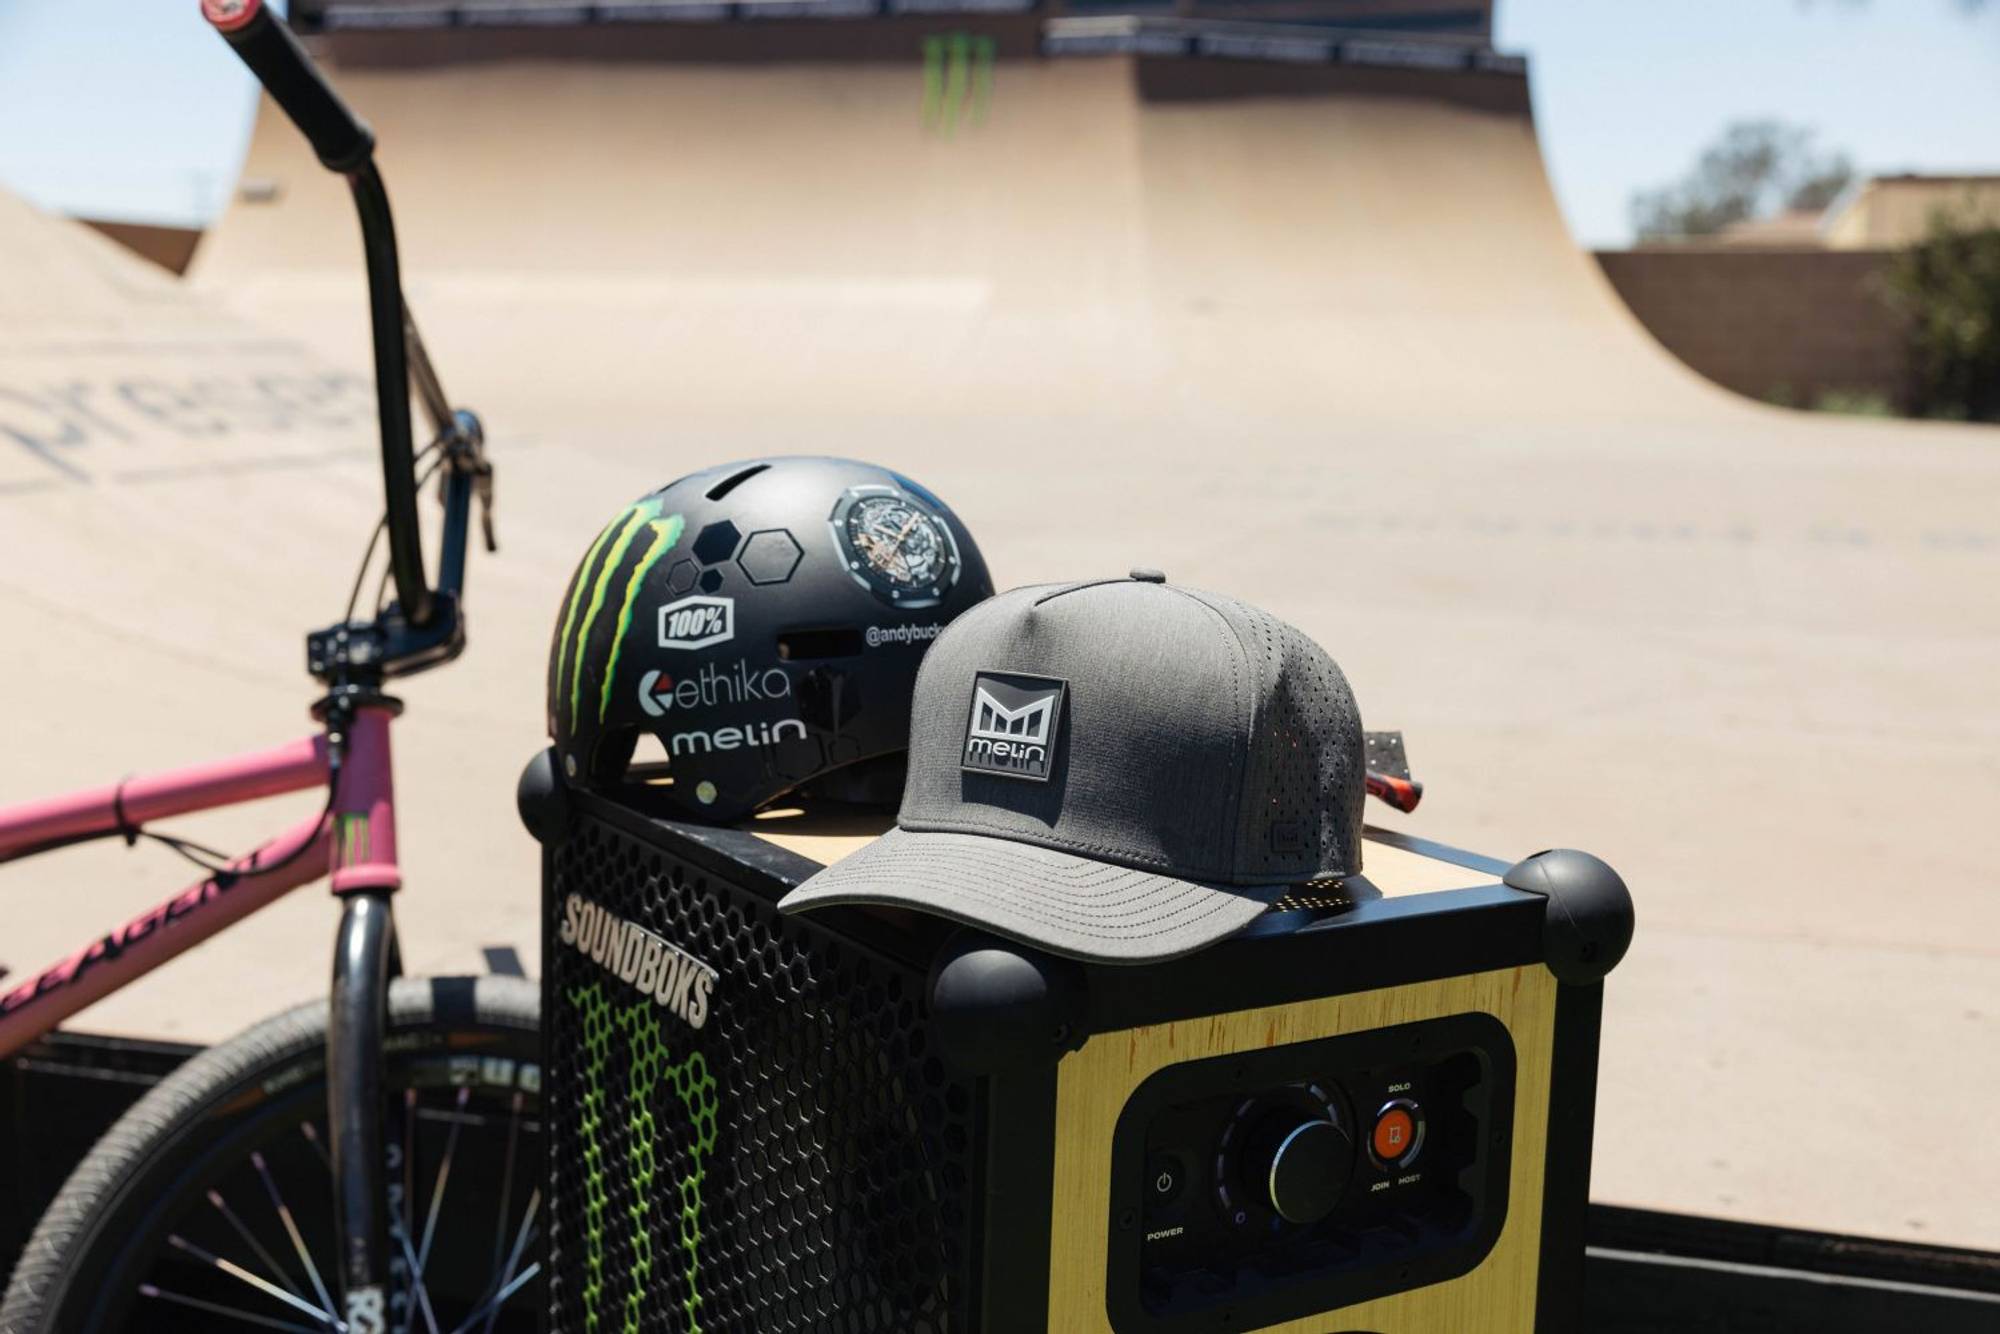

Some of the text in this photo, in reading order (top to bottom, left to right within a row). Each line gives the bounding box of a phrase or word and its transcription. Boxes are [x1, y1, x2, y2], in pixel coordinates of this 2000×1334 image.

[668, 606, 723, 638] 100%
[676, 657, 791, 709] ethika
[672, 718, 808, 756] melin
[968, 738, 1046, 761] melin
[561, 893, 714, 1029] SOUNDBOKS
[1387, 1082, 1411, 1093] SOLO
[1370, 1174, 1421, 1192] JOIN HOST
[1147, 1227, 1184, 1241] POWER
